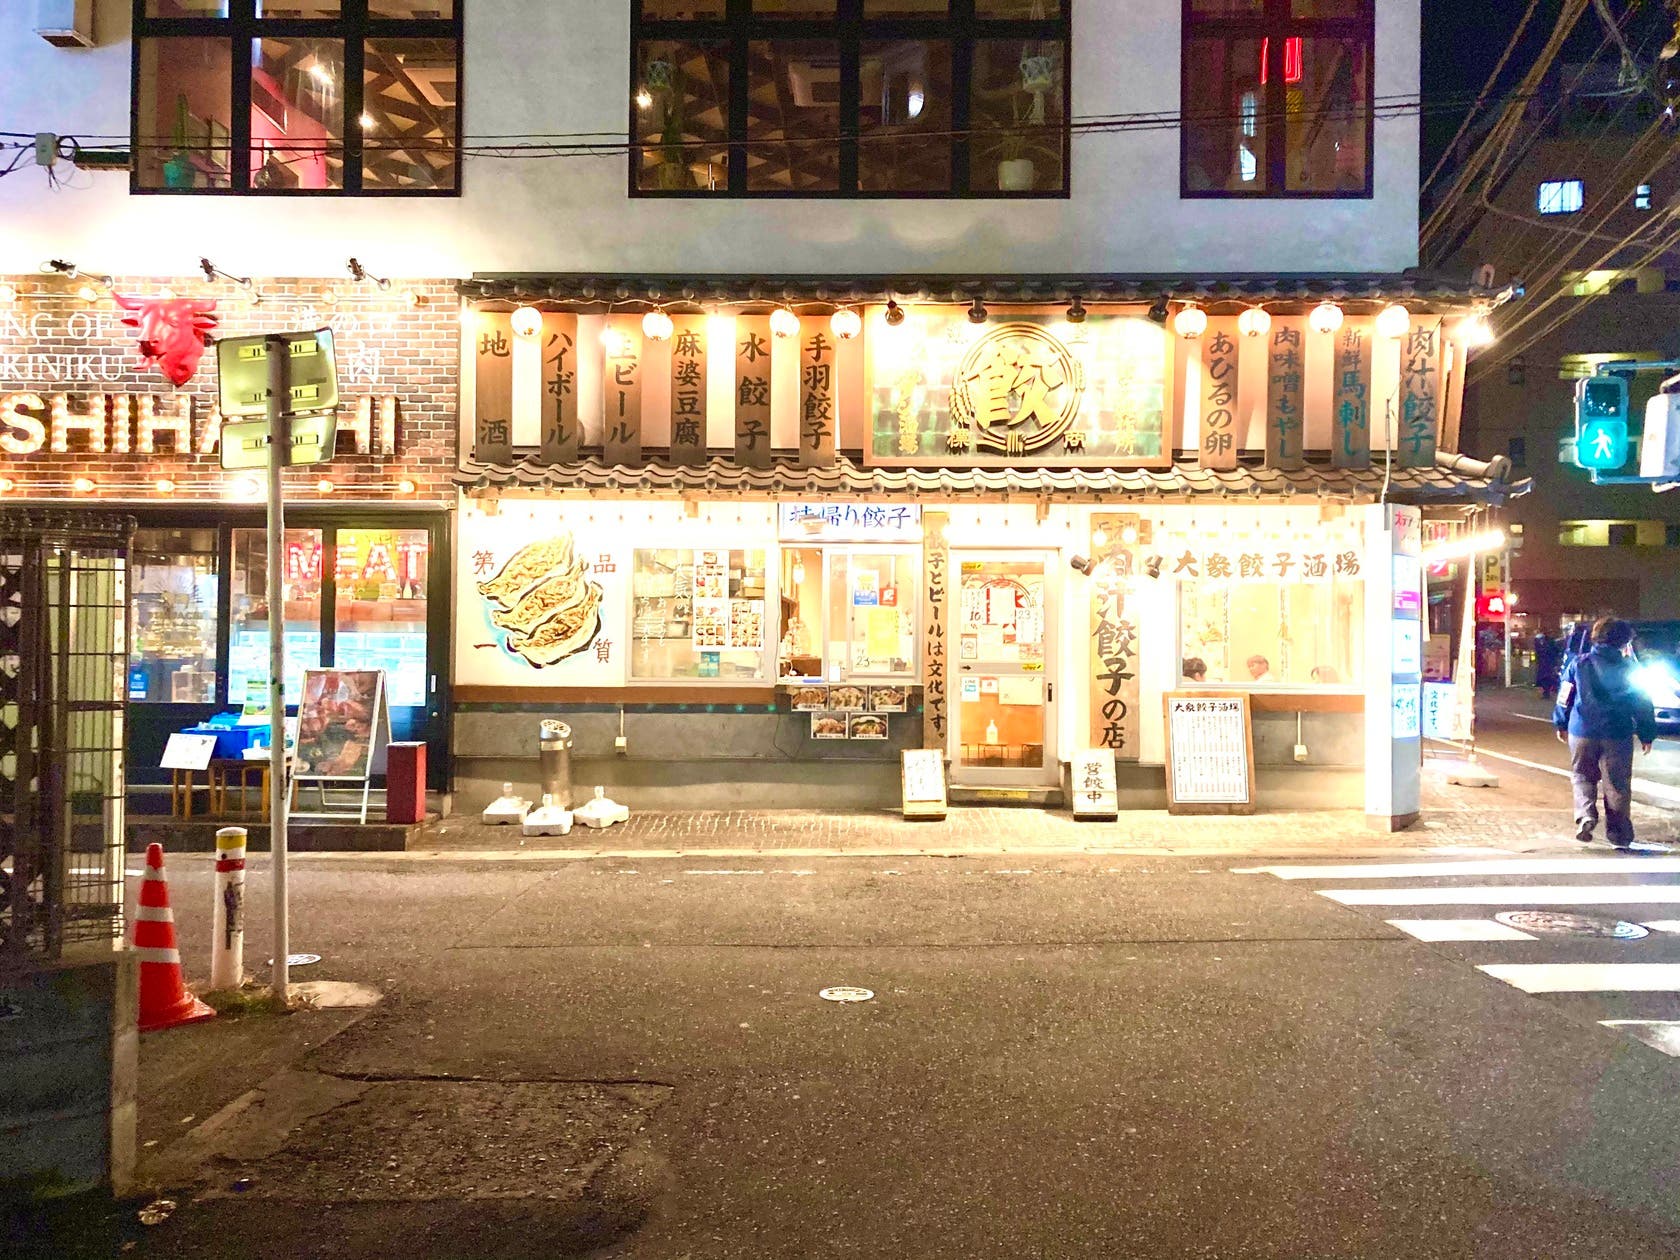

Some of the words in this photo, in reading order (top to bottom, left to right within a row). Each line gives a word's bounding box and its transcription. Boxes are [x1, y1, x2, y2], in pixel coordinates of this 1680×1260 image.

[67, 312, 113, 339] OF
[480, 331, 510, 446] 地酒
[547, 332, 576, 446] ハイボール
[674, 329, 703, 446] 麻婆豆腐
[737, 334, 769, 449] 水餃子
[802, 335, 833, 449] 手羽餃子
[1205, 331, 1235, 457] あひるの卵
[1272, 326, 1302, 458] 肉味噌もやし
[1337, 327, 1367, 457] 新鮮馬刺し
[1400, 325, 1435, 454] 肉汁餃子
[288, 543, 429, 580] MEAT
[1173, 550, 1360, 578] 大衆餃子酒場
